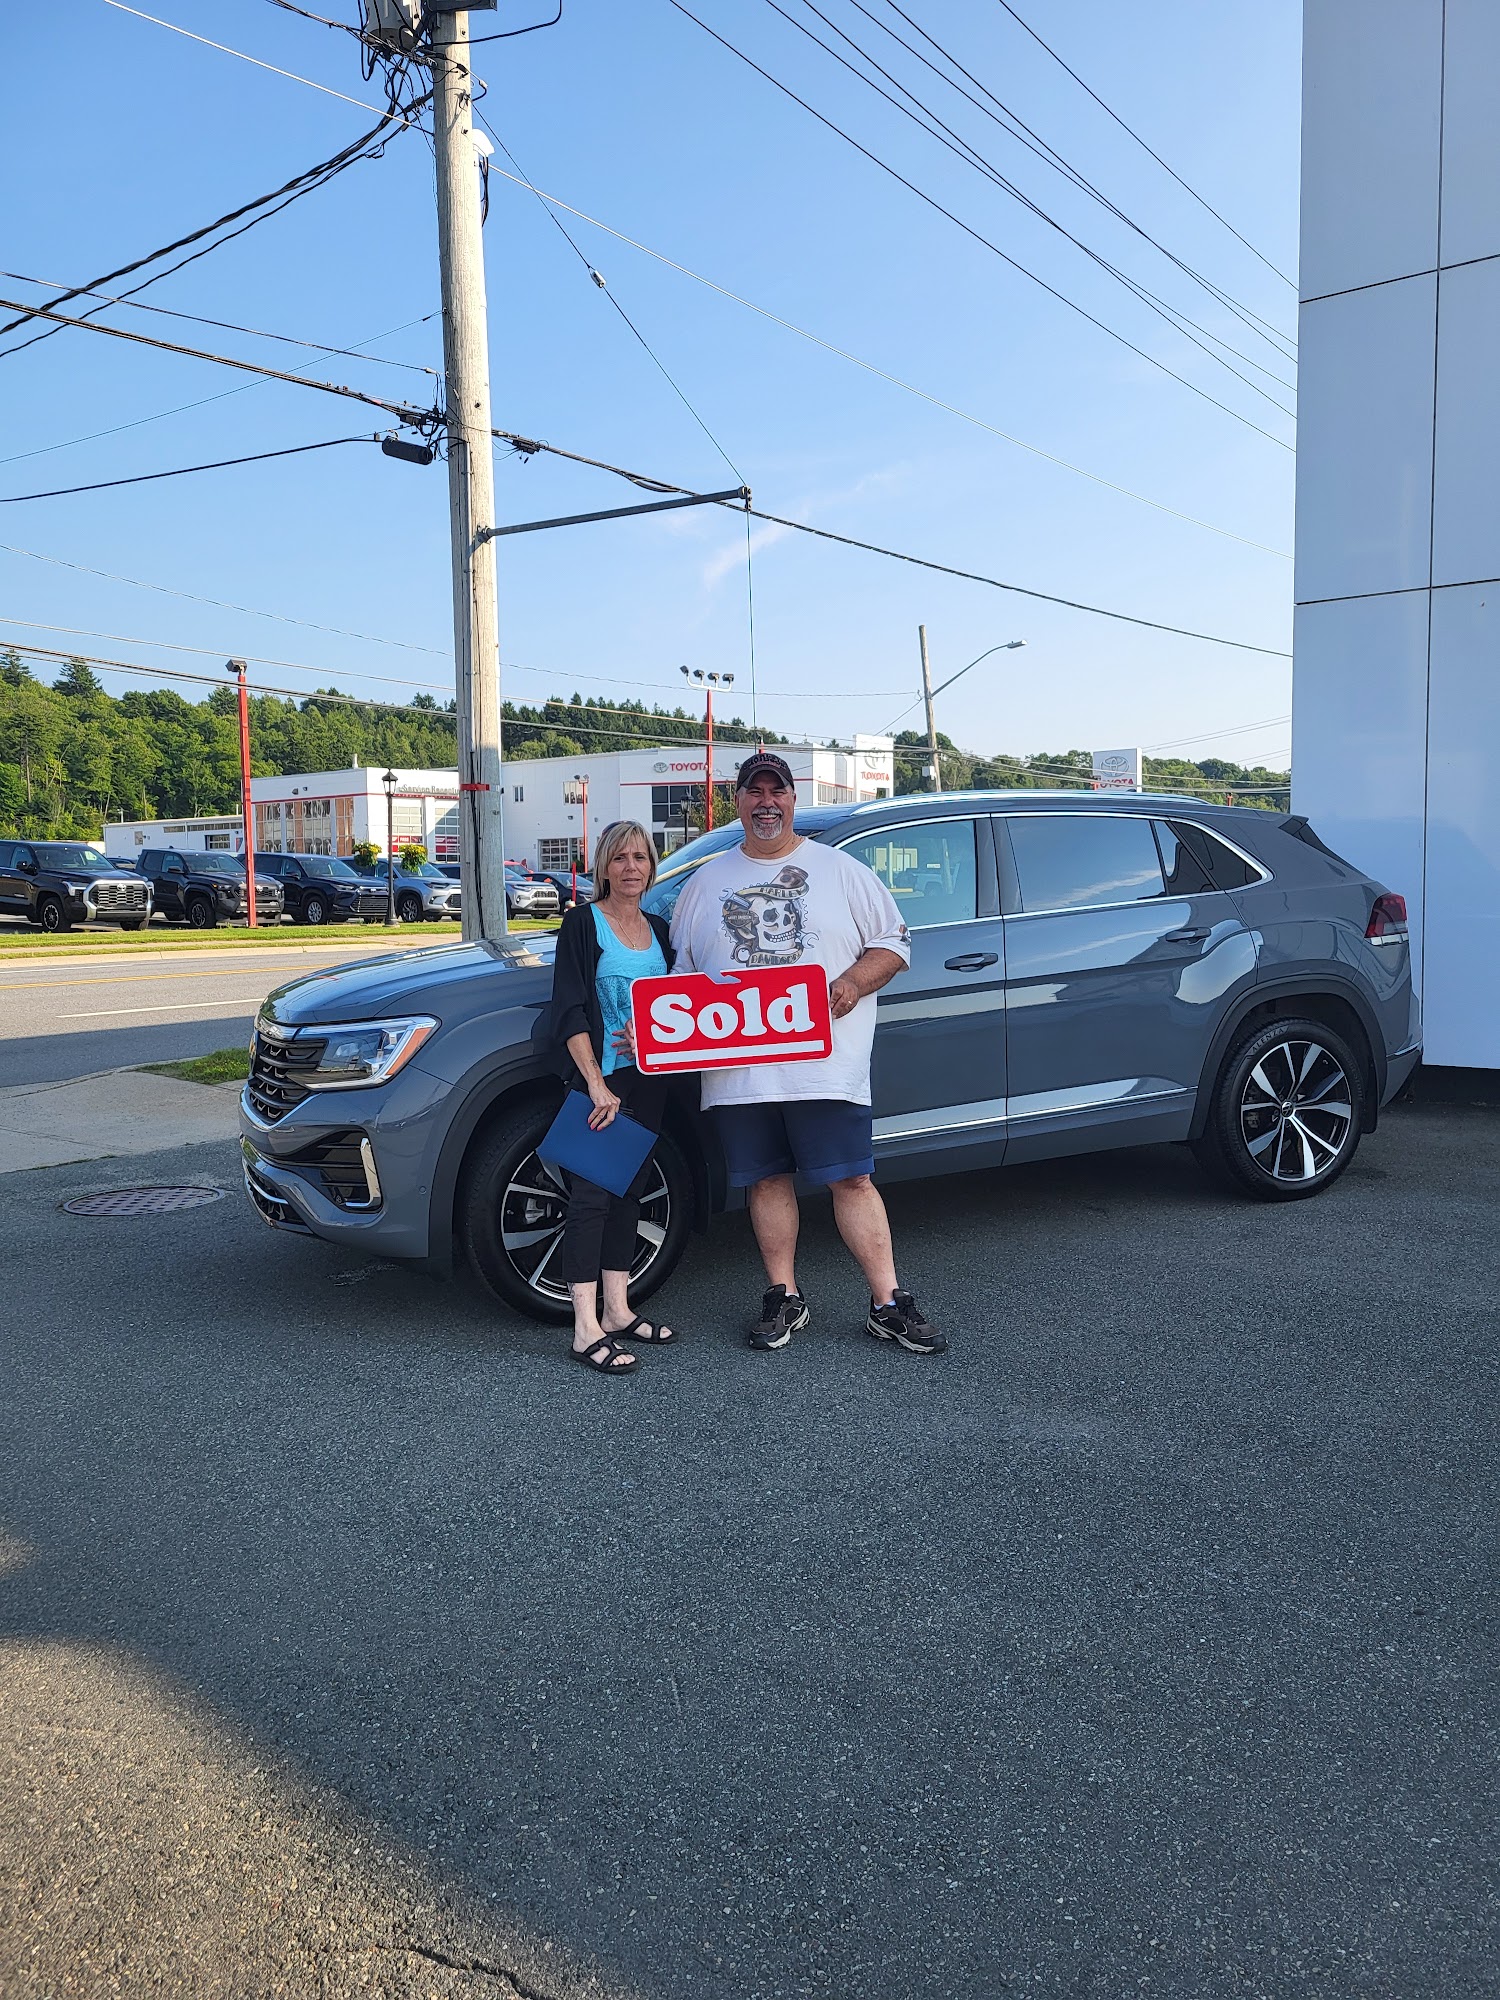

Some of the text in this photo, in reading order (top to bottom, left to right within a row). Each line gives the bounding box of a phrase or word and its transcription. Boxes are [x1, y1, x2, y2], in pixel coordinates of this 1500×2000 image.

[669, 762, 708, 771] TOYOTA
[861, 772, 890, 781] TOYOTA
[760, 887, 803, 898] HARLEY
[751, 952, 800, 965] DAVIDSON
[650, 983, 816, 1044] Sold
[1252, 1027, 1284, 1053] ALENZA
